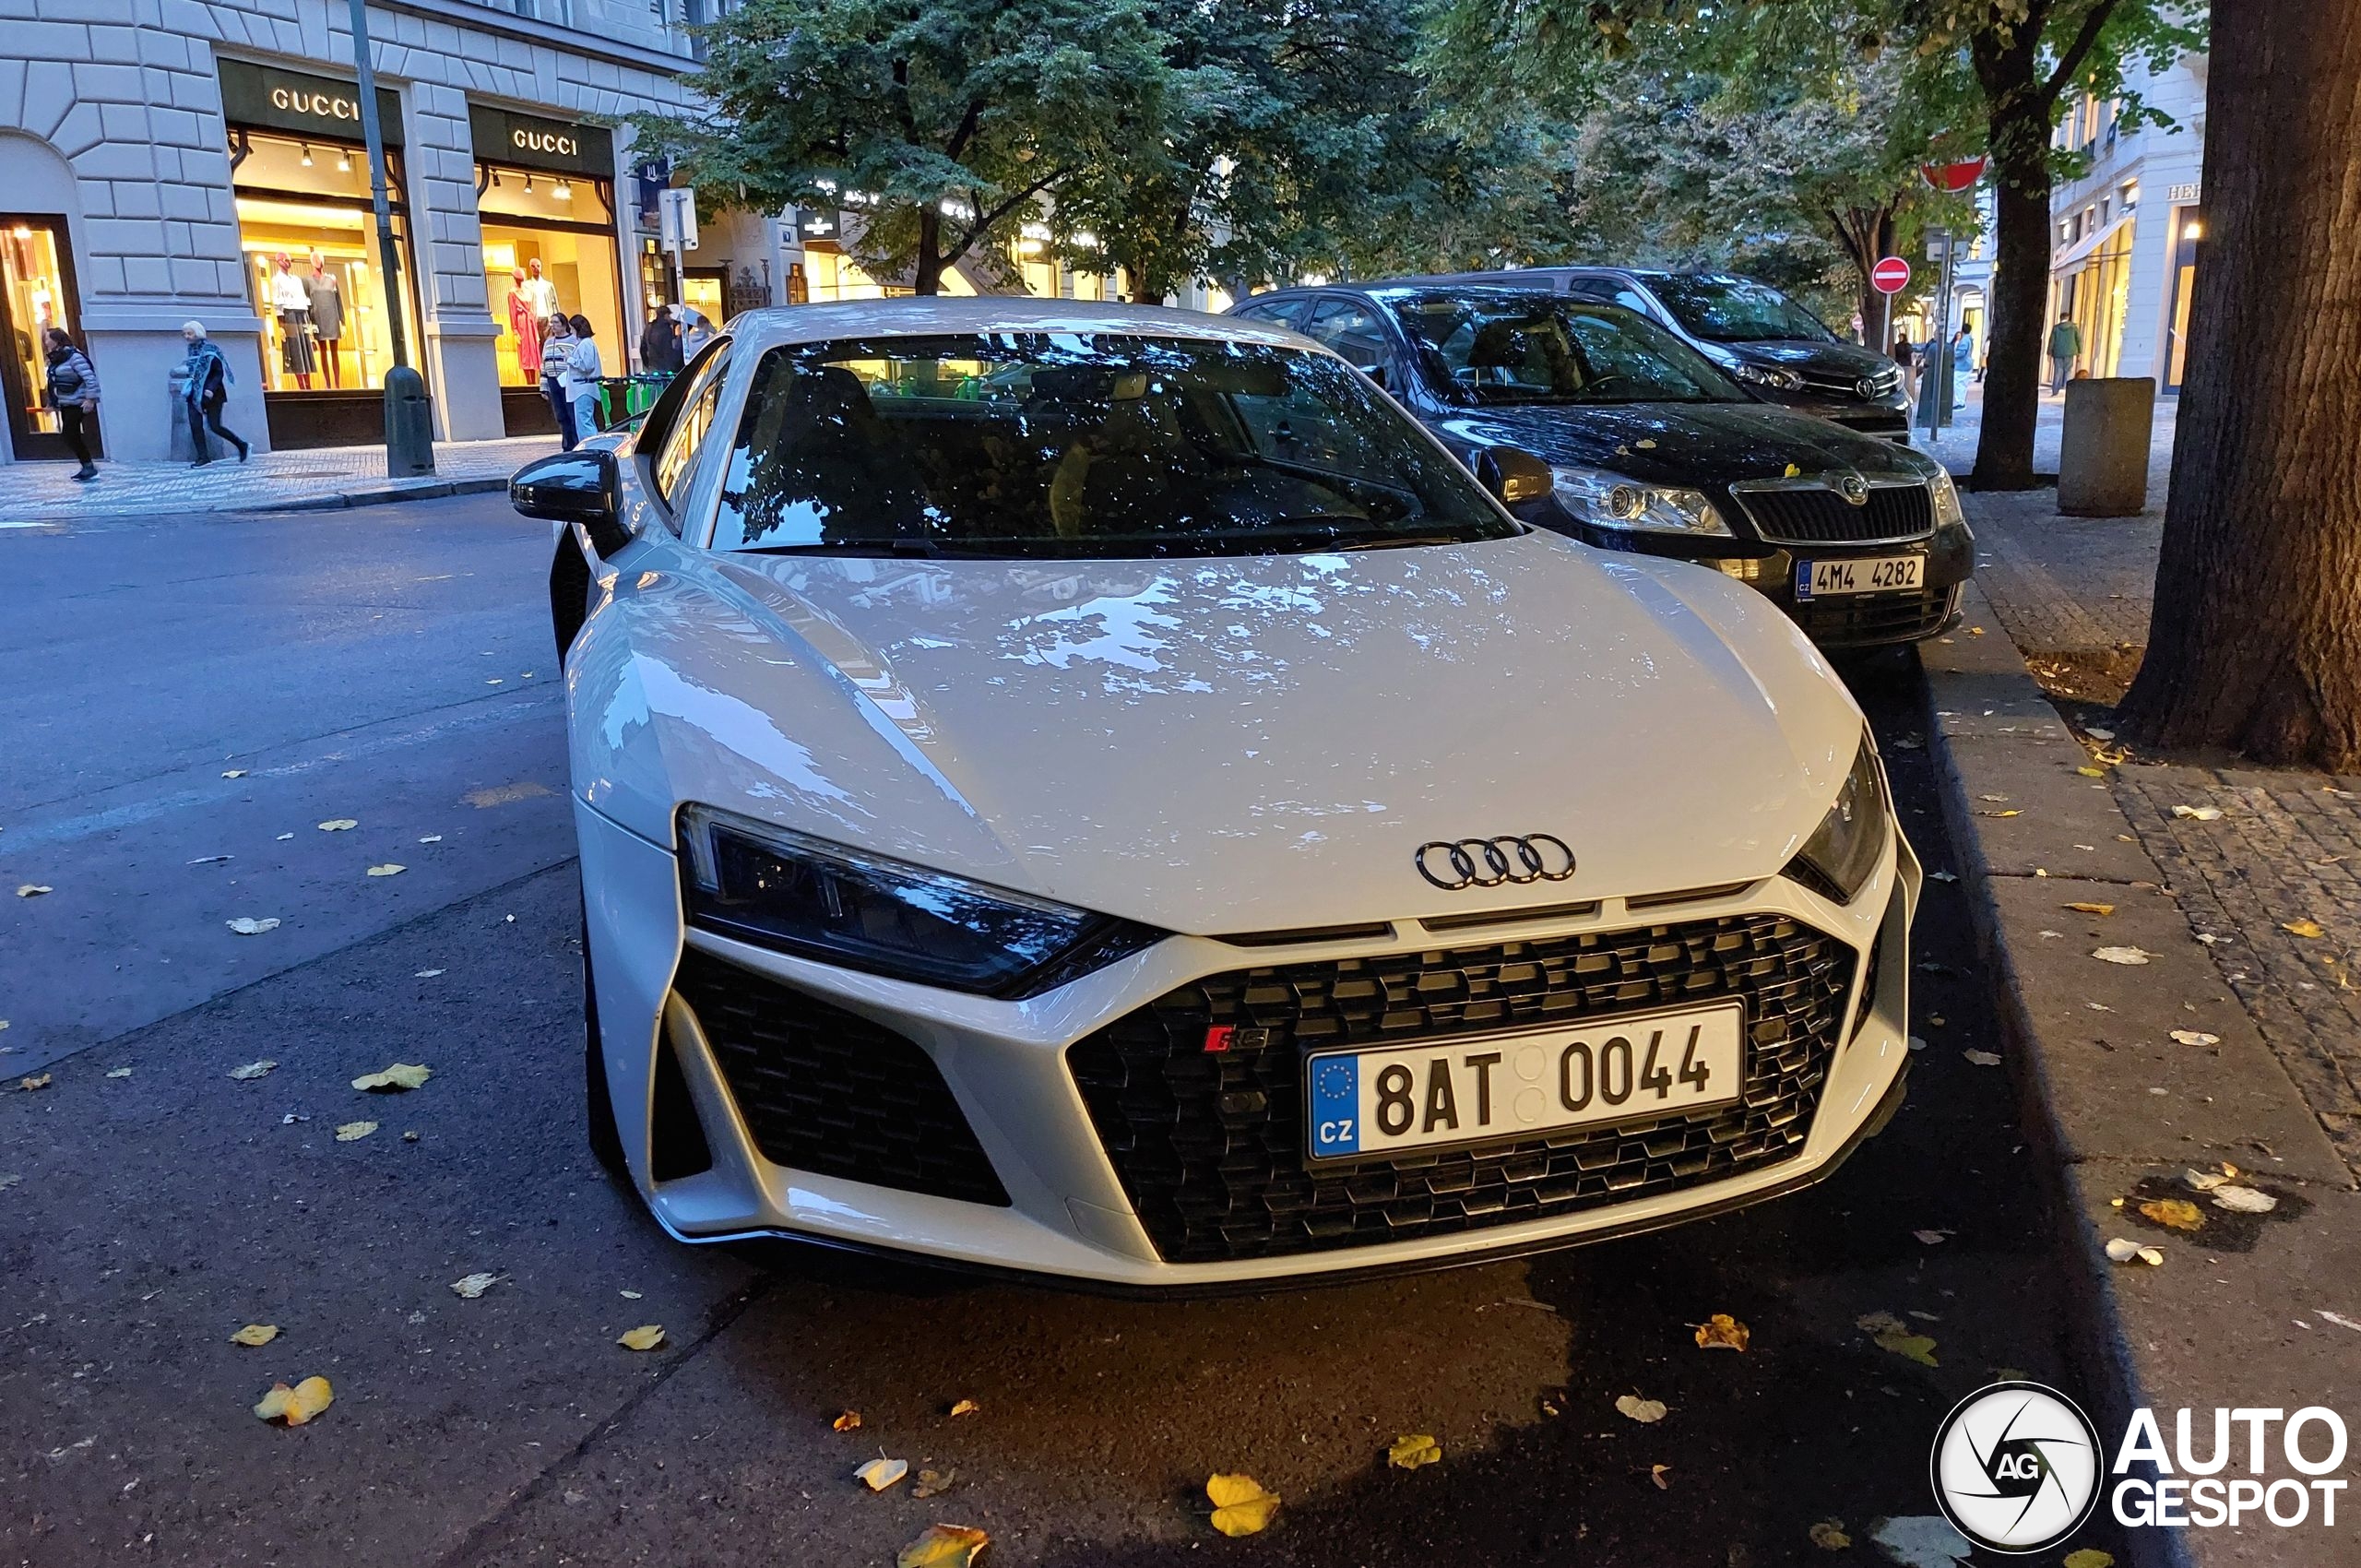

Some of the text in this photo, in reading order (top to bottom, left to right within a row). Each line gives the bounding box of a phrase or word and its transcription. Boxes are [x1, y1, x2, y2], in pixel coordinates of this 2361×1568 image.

[272, 89, 360, 121] GUCCI
[514, 129, 577, 156] GUCCI
[1798, 583, 1809, 592] CZ
[1817, 560, 1916, 590] 4M4 4282
[1376, 1024, 1710, 1136] 8AT 0044
[1320, 1119, 1353, 1144] CZ
